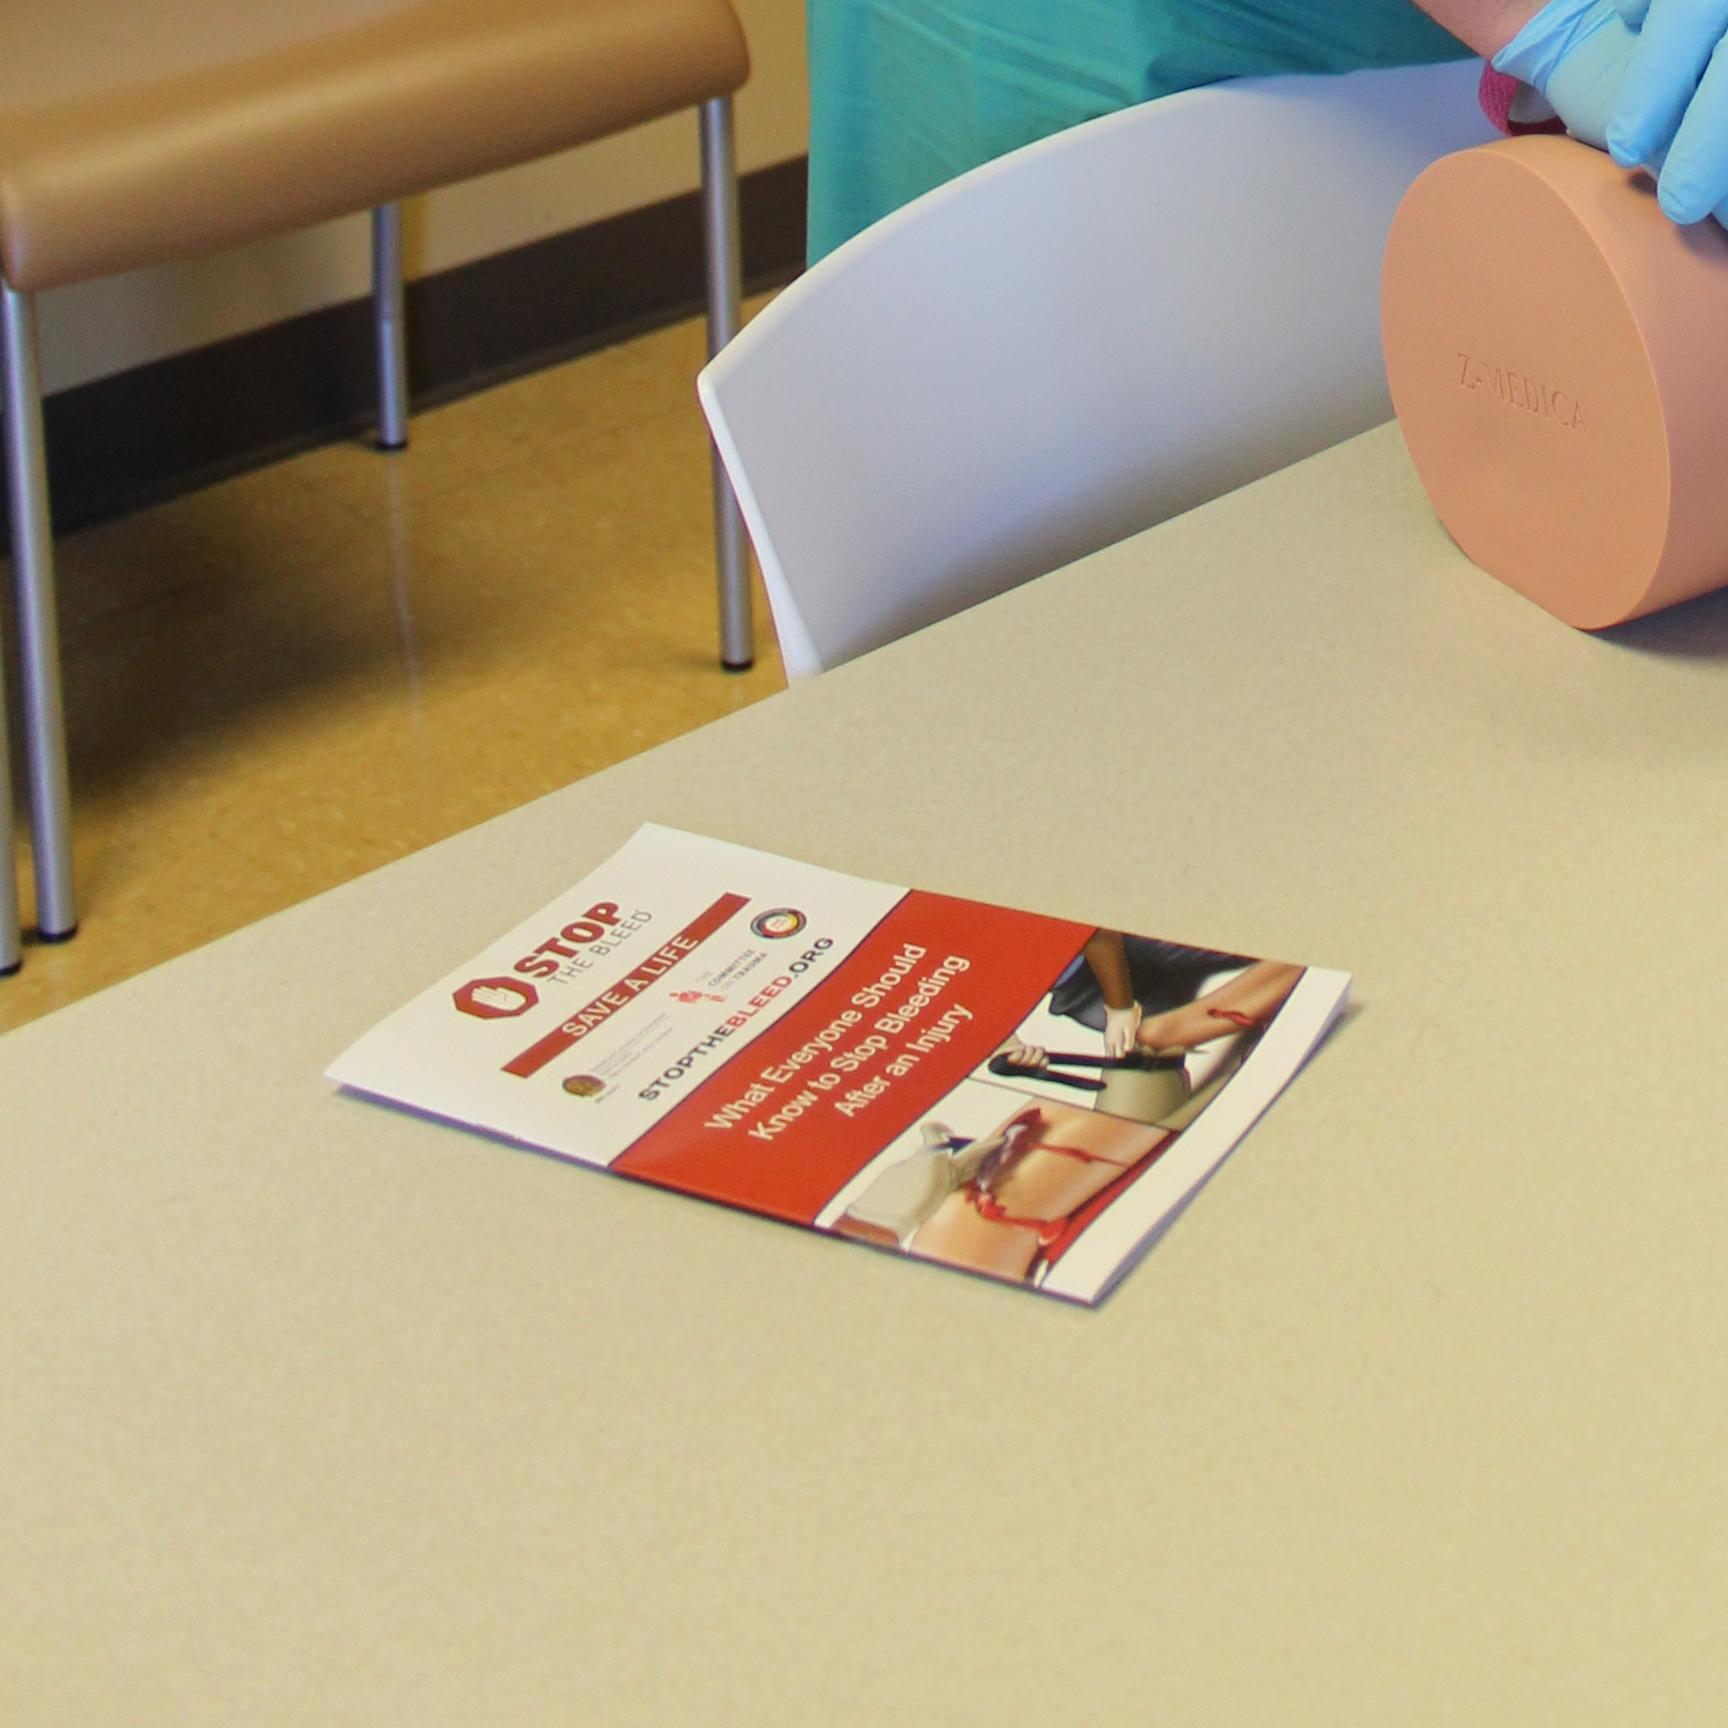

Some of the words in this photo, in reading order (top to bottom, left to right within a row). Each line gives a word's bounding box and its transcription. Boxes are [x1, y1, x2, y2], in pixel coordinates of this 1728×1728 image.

[1457, 352, 1587, 432] Z-MEDICA
[513, 900, 622, 979] STOP
[546, 956, 595, 987] THE
[589, 907, 653, 957] BLEED
[707, 948, 756, 988] COMMITTEE
[733, 952, 769, 981] TRAUMA
[561, 991, 630, 1038] SAVE
[628, 975, 648, 993] A
[642, 934, 700, 976] LIFE
[638, 936, 834, 1102] STOPTHEBLEED.ORG
[704, 1083, 777, 1132] What
[760, 1009, 865, 1085] Everyone
[851, 943, 928, 1009] Should
[747, 1089, 819, 1143] Know
[809, 1070, 842, 1093] to
[830, 1033, 889, 1074] Stop
[874, 954, 972, 1035] Bleeding
[834, 1075, 892, 1119] After
[886, 1054, 922, 1079] an
[905, 1003, 975, 1054] Injury
